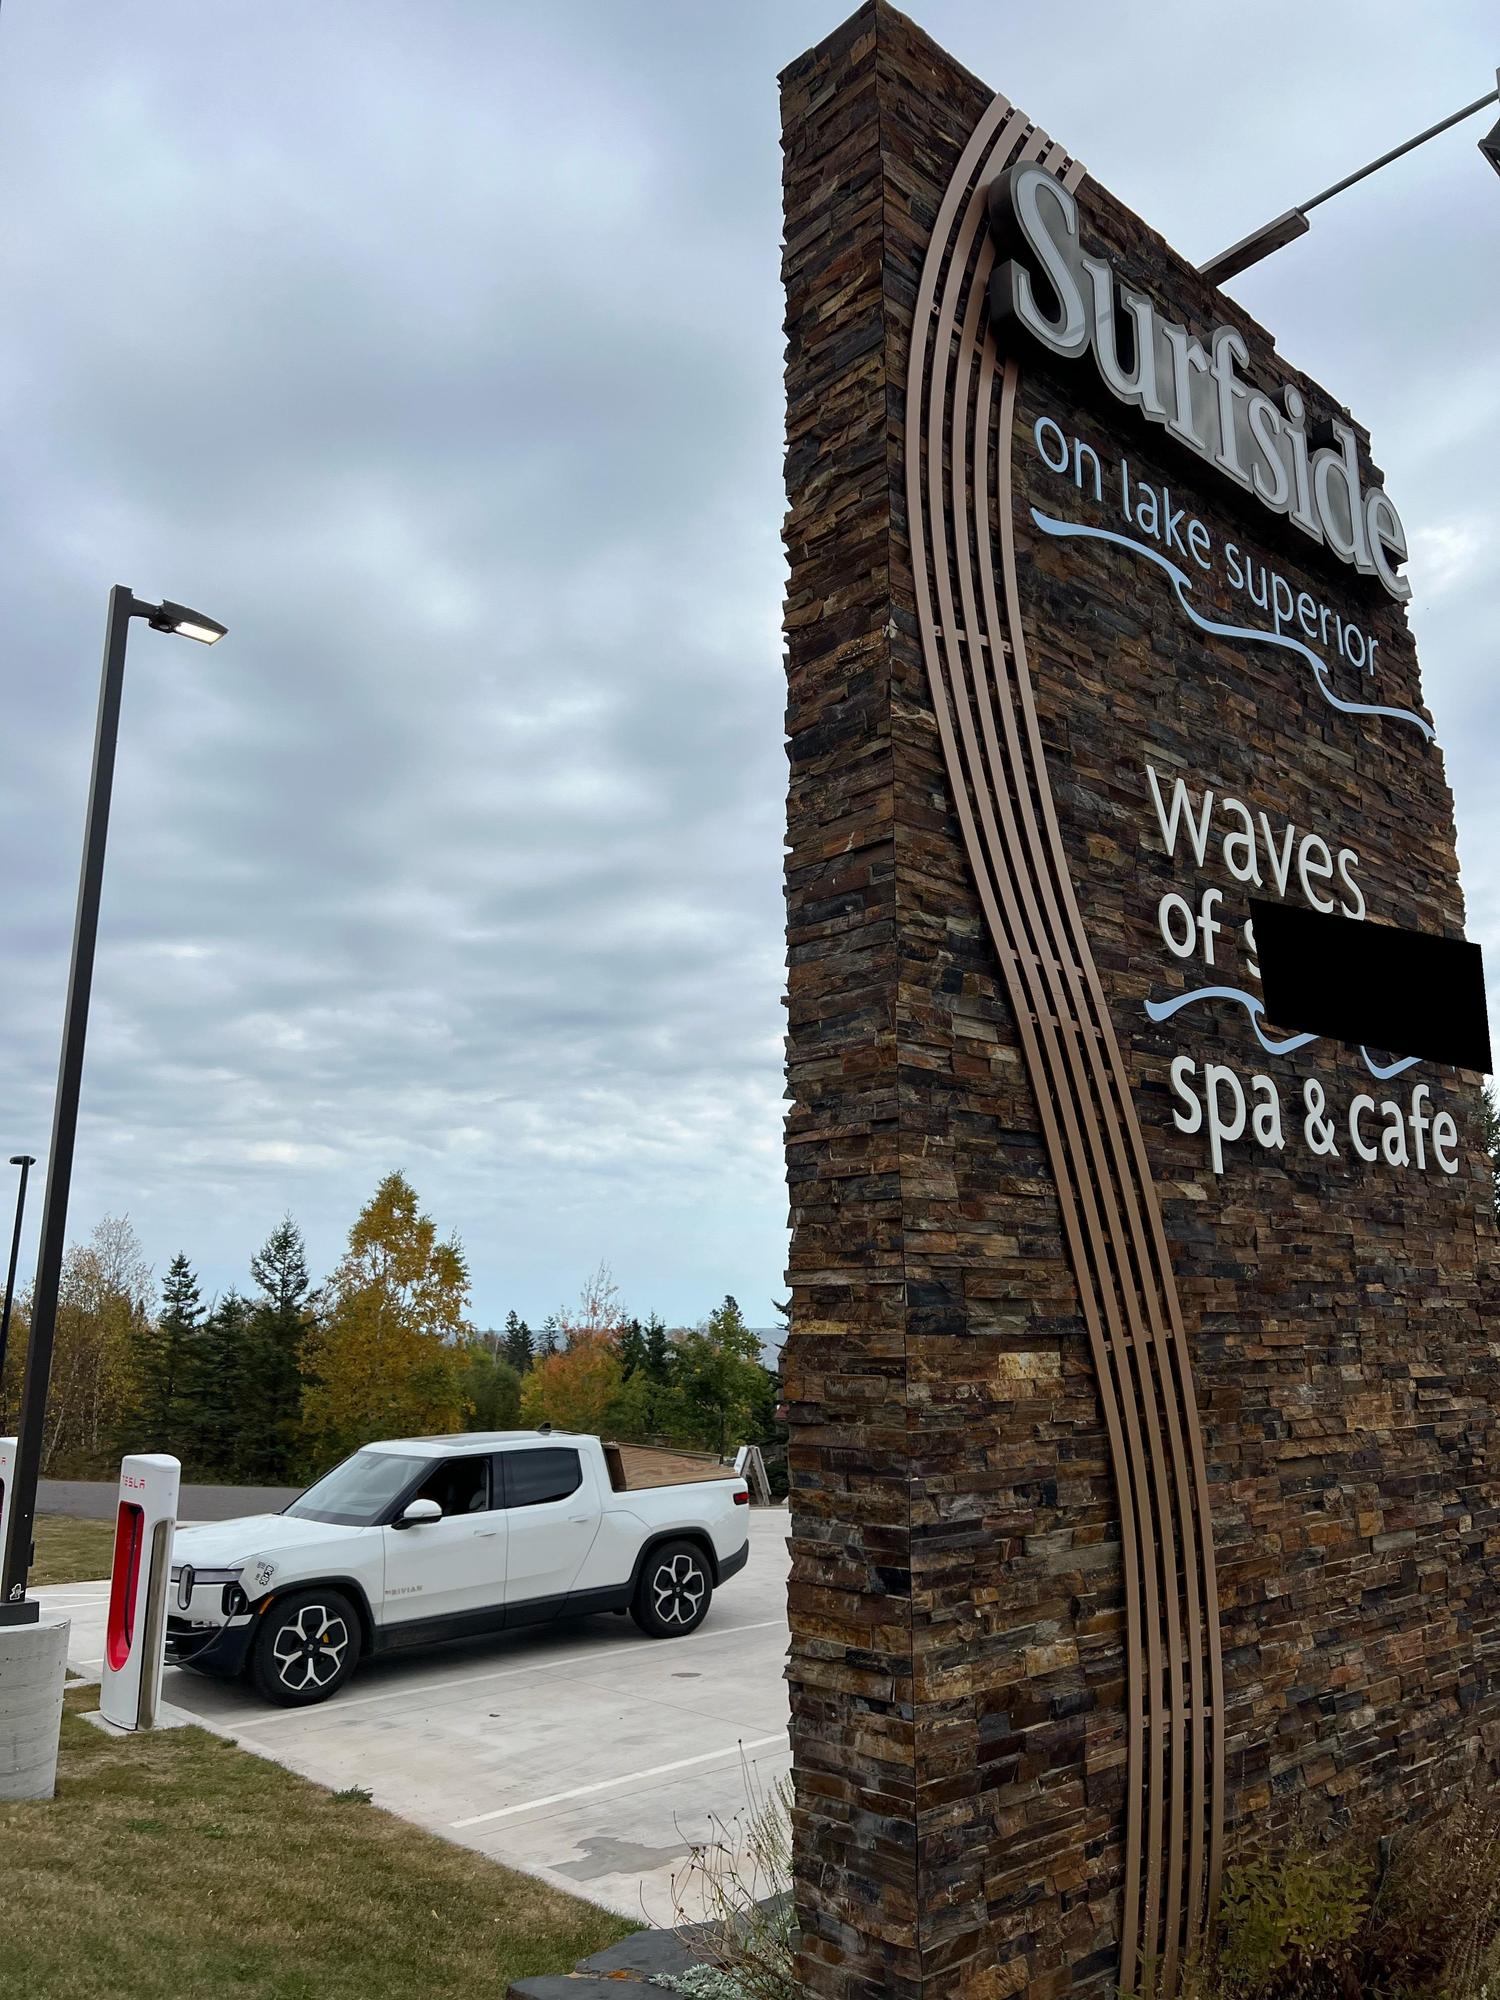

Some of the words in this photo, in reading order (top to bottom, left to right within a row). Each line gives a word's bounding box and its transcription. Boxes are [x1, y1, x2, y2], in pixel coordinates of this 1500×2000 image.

[1008, 160, 1411, 600] Surfside
[1034, 416, 1102, 502] on
[1121, 458, 1212, 570] lake
[1158, 887, 1223, 966] of
[1170, 1055, 1286, 1174] spa
[1303, 1078, 1340, 1157] &
[1348, 1084, 1459, 1174] cafe
[121, 1474, 146, 1490] TESLA
